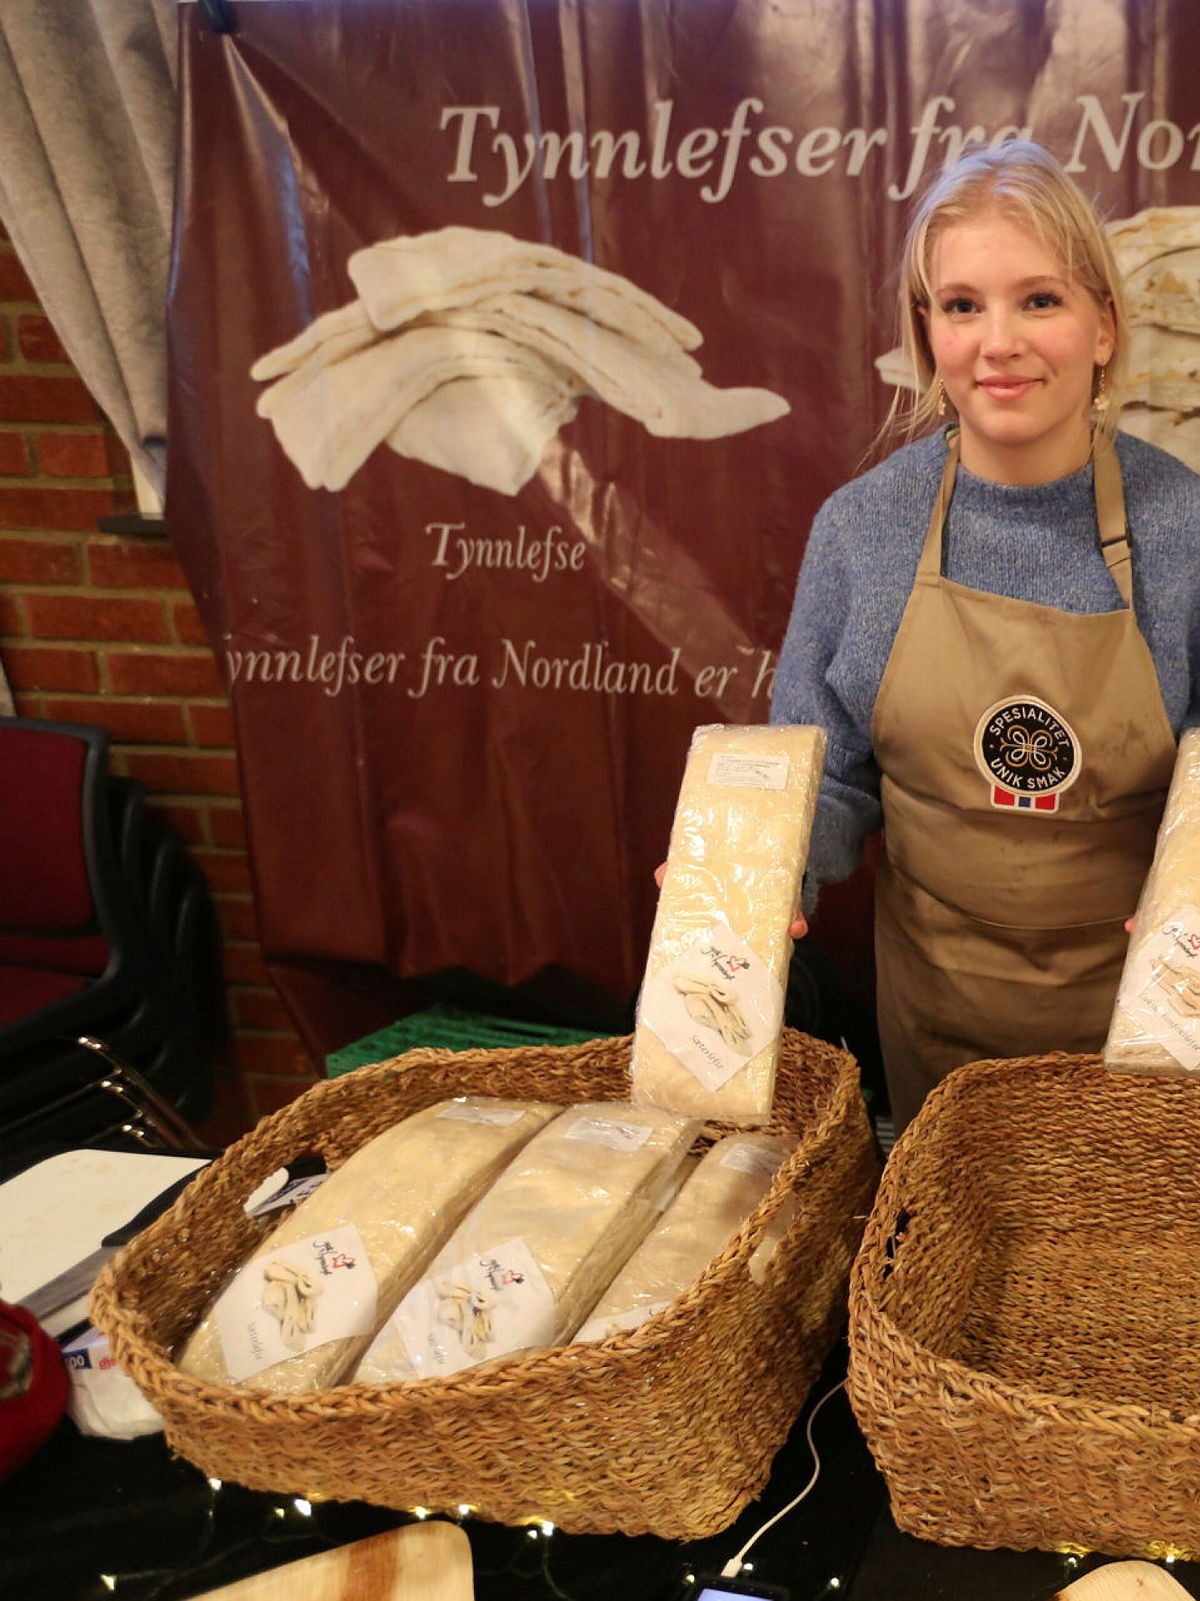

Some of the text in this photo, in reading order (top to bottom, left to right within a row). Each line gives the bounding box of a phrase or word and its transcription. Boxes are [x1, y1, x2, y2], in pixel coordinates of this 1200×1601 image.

[438, 97, 887, 207] Tynnlefser
[424, 521, 587, 582] Tynnlefse
[224, 633, 777, 700] ynnlefser fra Nordland er h
[988, 706, 1071, 748] SPESIALITET
[989, 757, 1066, 790] UNIK SMAK
